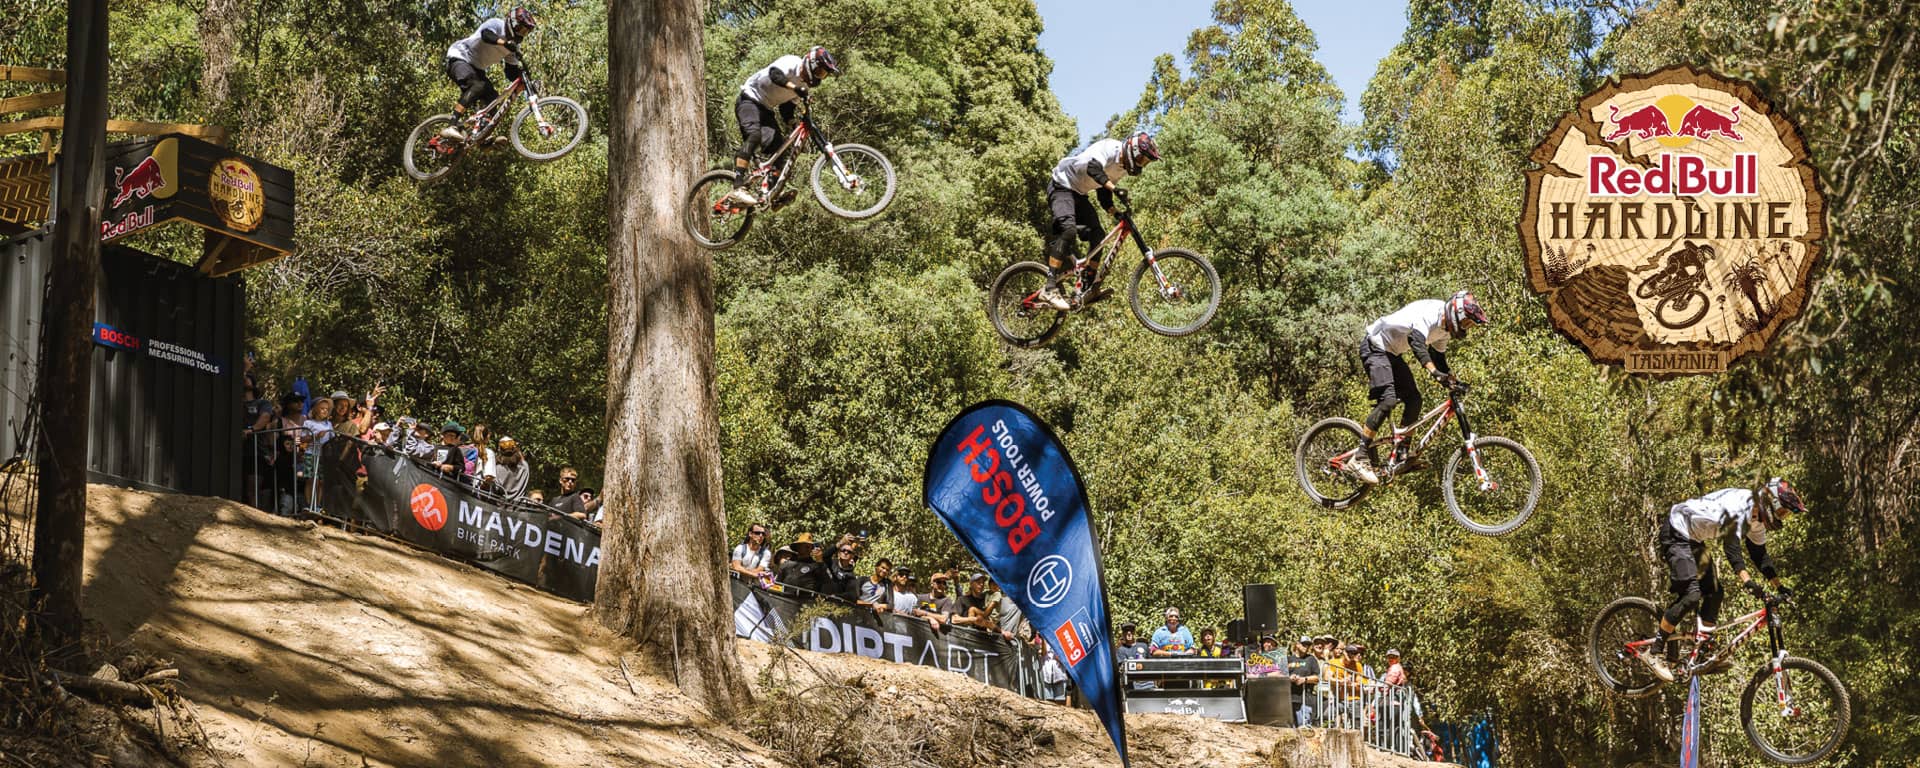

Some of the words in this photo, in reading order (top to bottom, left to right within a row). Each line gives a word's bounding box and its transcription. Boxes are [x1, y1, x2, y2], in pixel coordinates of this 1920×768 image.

[101, 214, 127, 240] Red
[128, 205, 154, 231] Bull
[100, 328, 140, 349] BOSCH
[149, 339, 206, 361] PROFESSIONAL
[148, 348, 195, 366] MEASURING
[196, 360, 220, 374] TOOLS
[991, 419, 1025, 468] TOOLS
[956, 424, 1041, 555] BOSCH
[1001, 466, 1056, 523] POWER
[457, 528, 485, 547] BIKE
[490, 541, 521, 561] PARK
[458, 502, 601, 567] MAYDENA
[1070, 648, 1081, 661] 6
